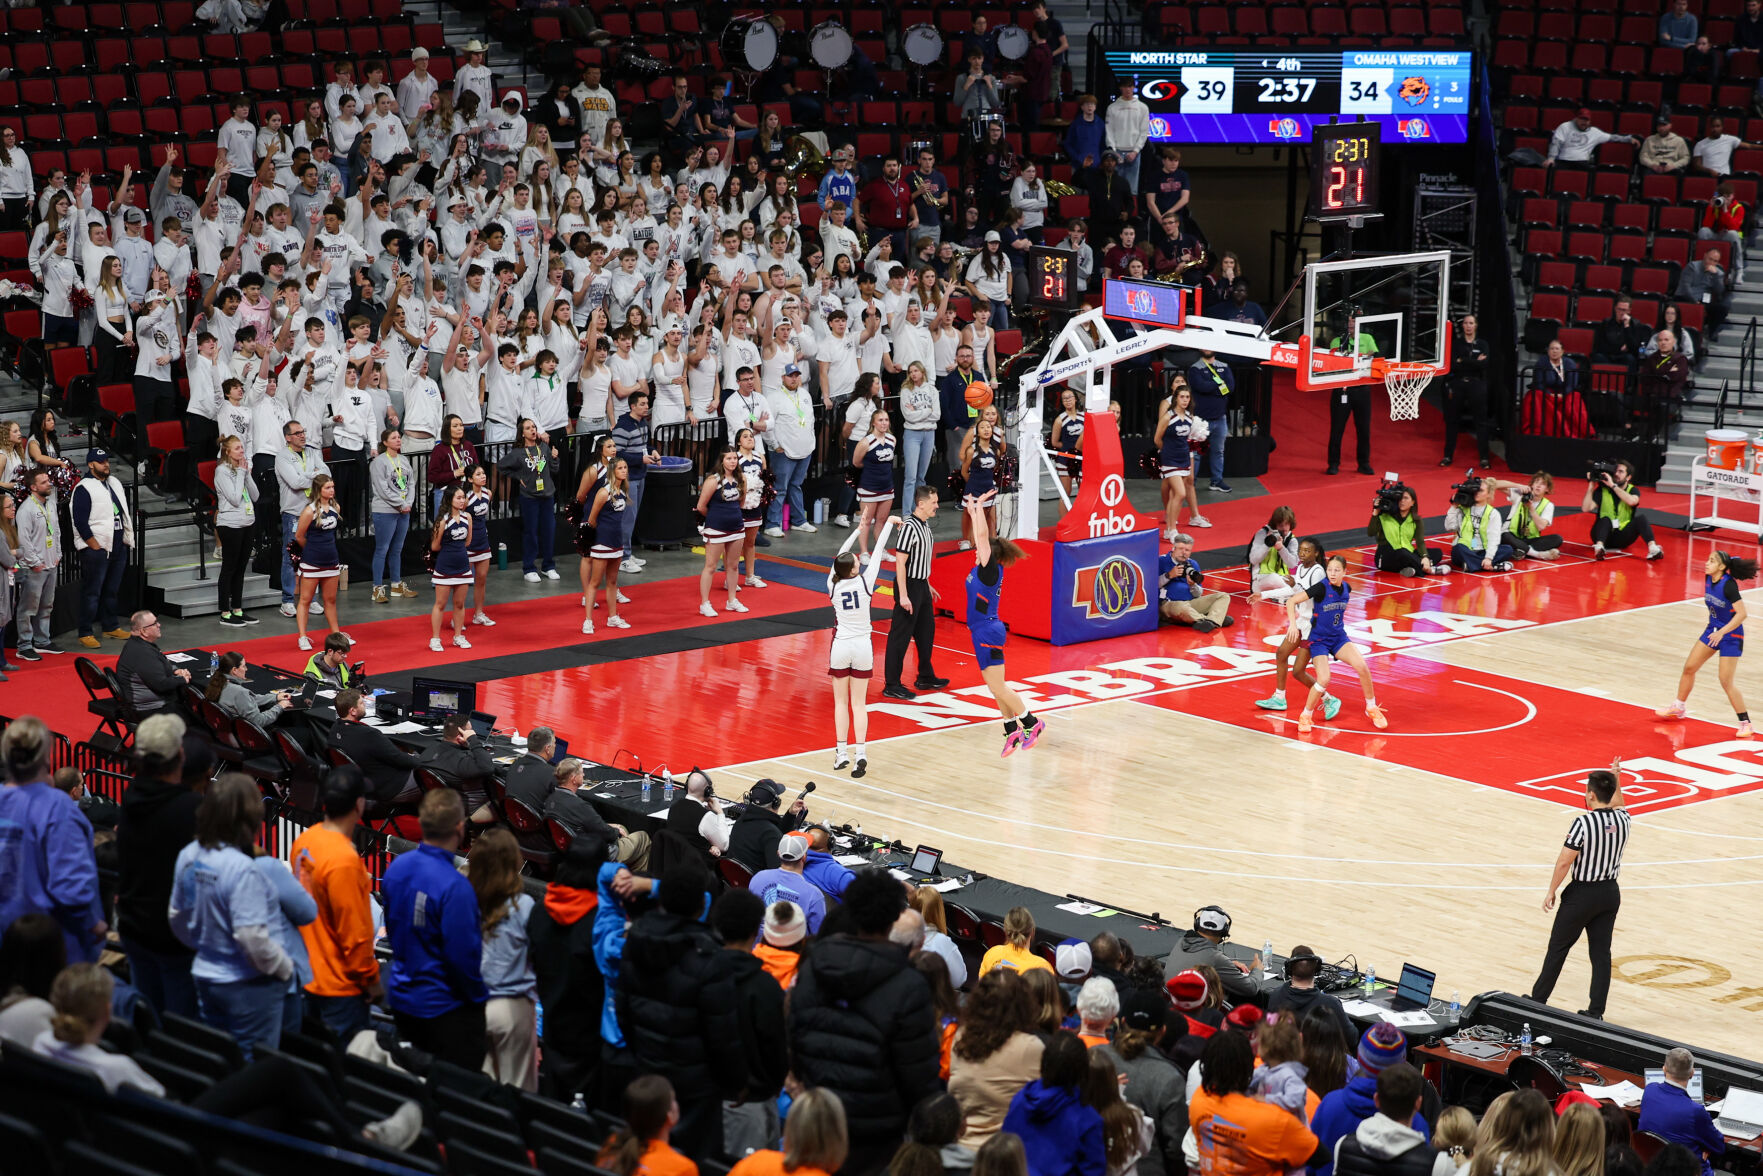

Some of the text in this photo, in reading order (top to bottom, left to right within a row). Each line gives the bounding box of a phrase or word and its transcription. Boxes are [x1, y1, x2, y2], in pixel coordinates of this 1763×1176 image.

[1130, 52, 1208, 64] NORTH STAR
[1276, 57, 1301, 71] 4th
[1354, 54, 1459, 66] OMAHA WESTVIEW
[1197, 80, 1227, 102] 39
[1257, 78, 1317, 103] 2:37
[1349, 81, 1379, 102] 34
[1450, 81, 1459, 92] 3
[583, 103, 609, 111] WARS
[584, 97, 607, 105] STAR
[1334, 138, 1368, 163] 2:37
[1419, 172, 1457, 182] Pinnacle
[1327, 166, 1364, 207] 21
[1043, 275, 1063, 298] 21
[1115, 338, 1149, 355] LEGACY
[1056, 360, 1088, 375] SPORTS
[1707, 445, 1717, 458] G
[1706, 471, 1750, 486] GATORADE
[1088, 509, 1136, 538] fnbo
[841, 590, 860, 610] 21
